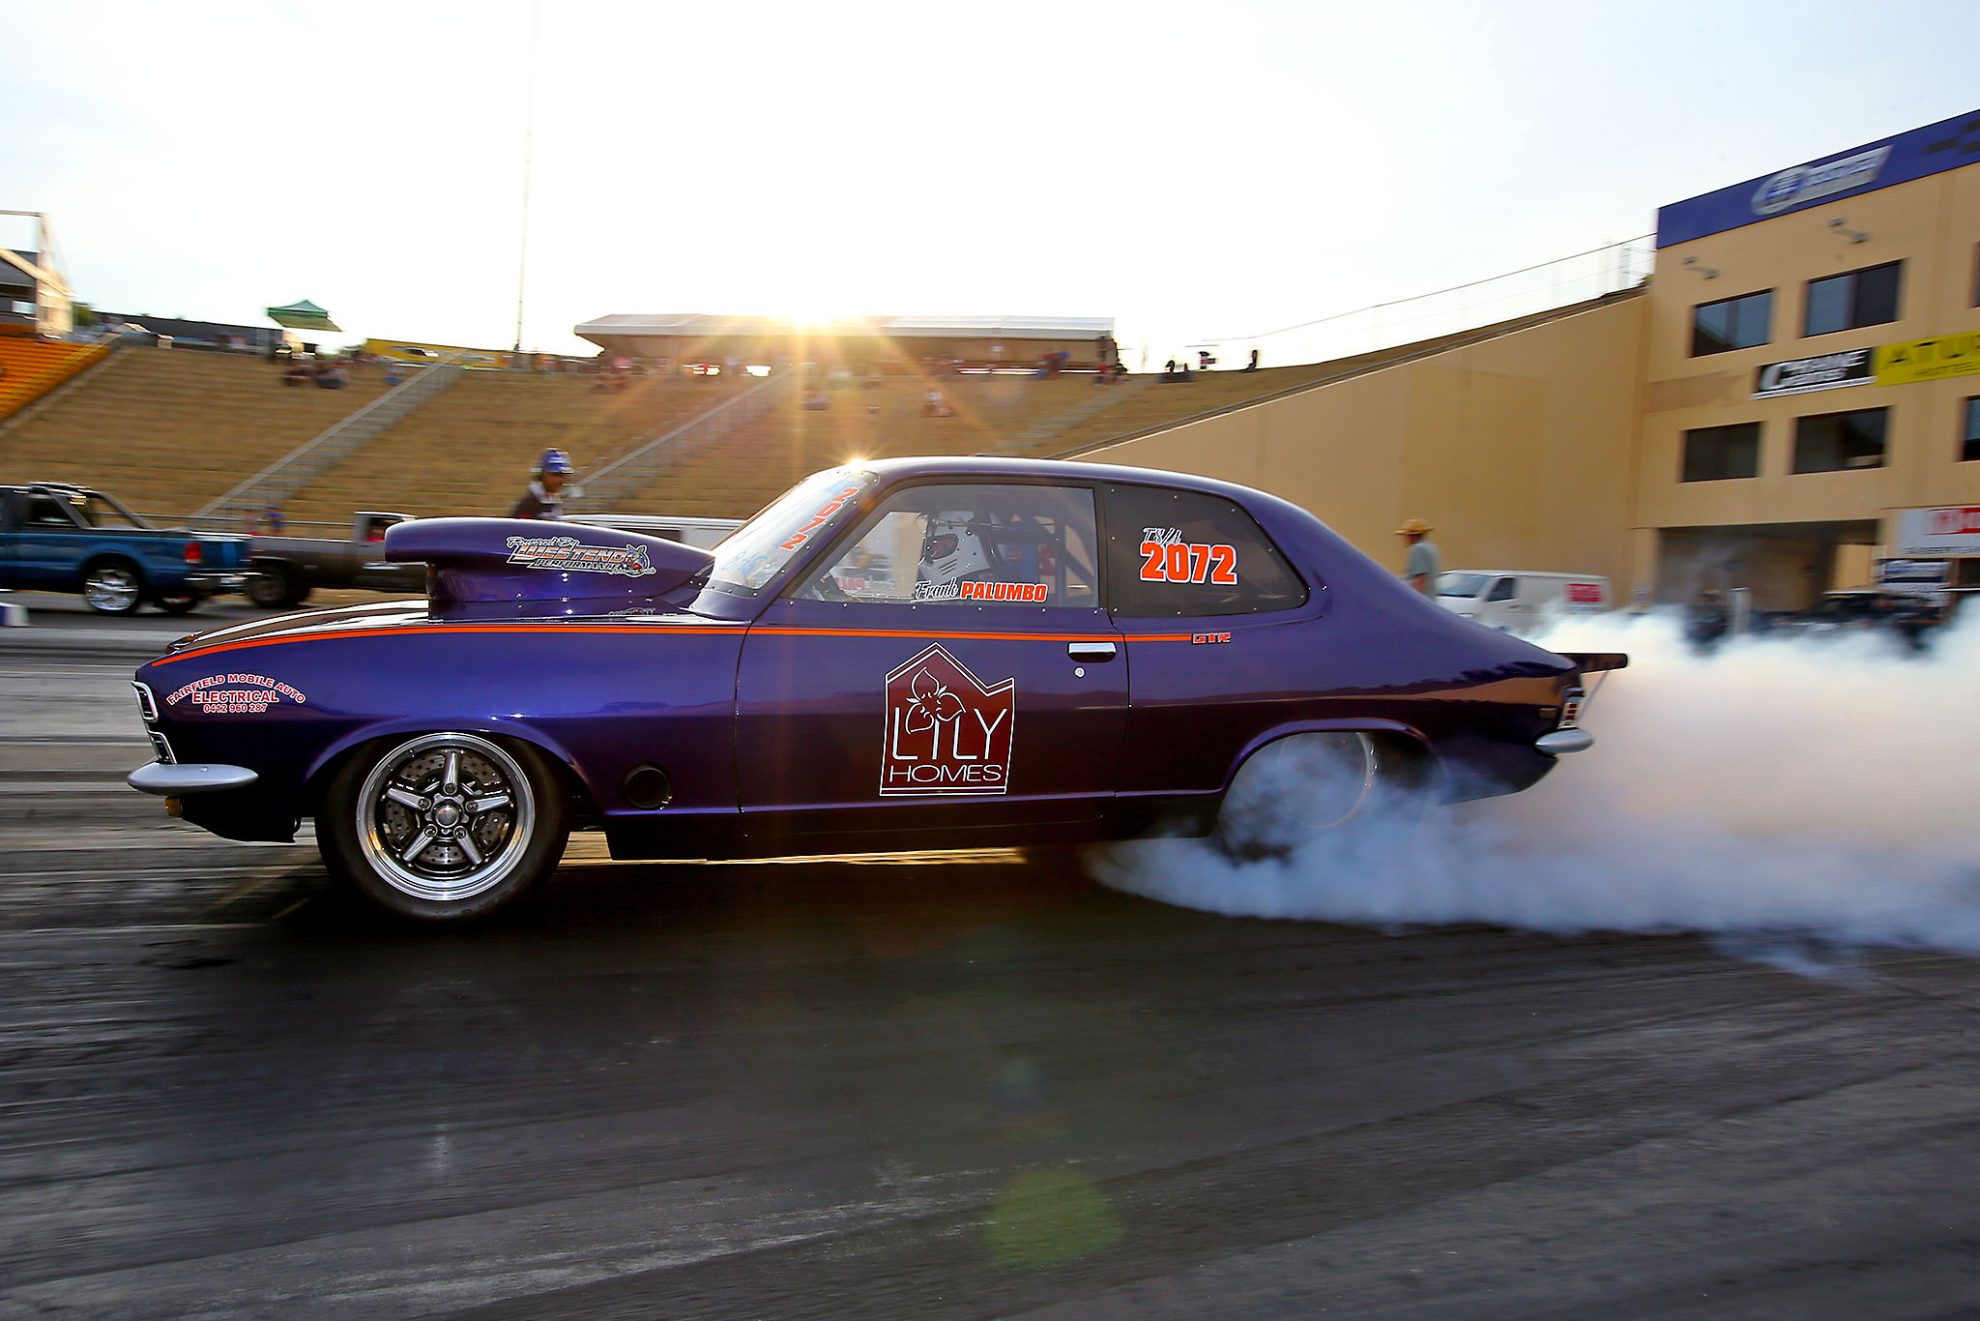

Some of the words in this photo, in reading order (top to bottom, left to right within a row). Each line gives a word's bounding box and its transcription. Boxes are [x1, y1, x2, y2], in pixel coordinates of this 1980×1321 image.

[506, 536, 556, 549] Powered
[556, 537, 580, 548] By
[513, 545, 625, 564] WESTEND
[1140, 541, 1238, 585] 2072
[915, 577, 959, 601] Frank
[959, 581, 1049, 603] PALUMBO
[166, 674, 226, 705] FAIRFIELD
[227, 673, 275, 688] MOBILE
[274, 682, 306, 704] AUTO
[192, 690, 280, 704] ELECTRICAL
[203, 704, 227, 713] 0412
[229, 704, 247, 713] 960
[249, 703, 269, 713] 287
[892, 707, 1008, 760] LILY
[888, 764, 1003, 783] HOMES
